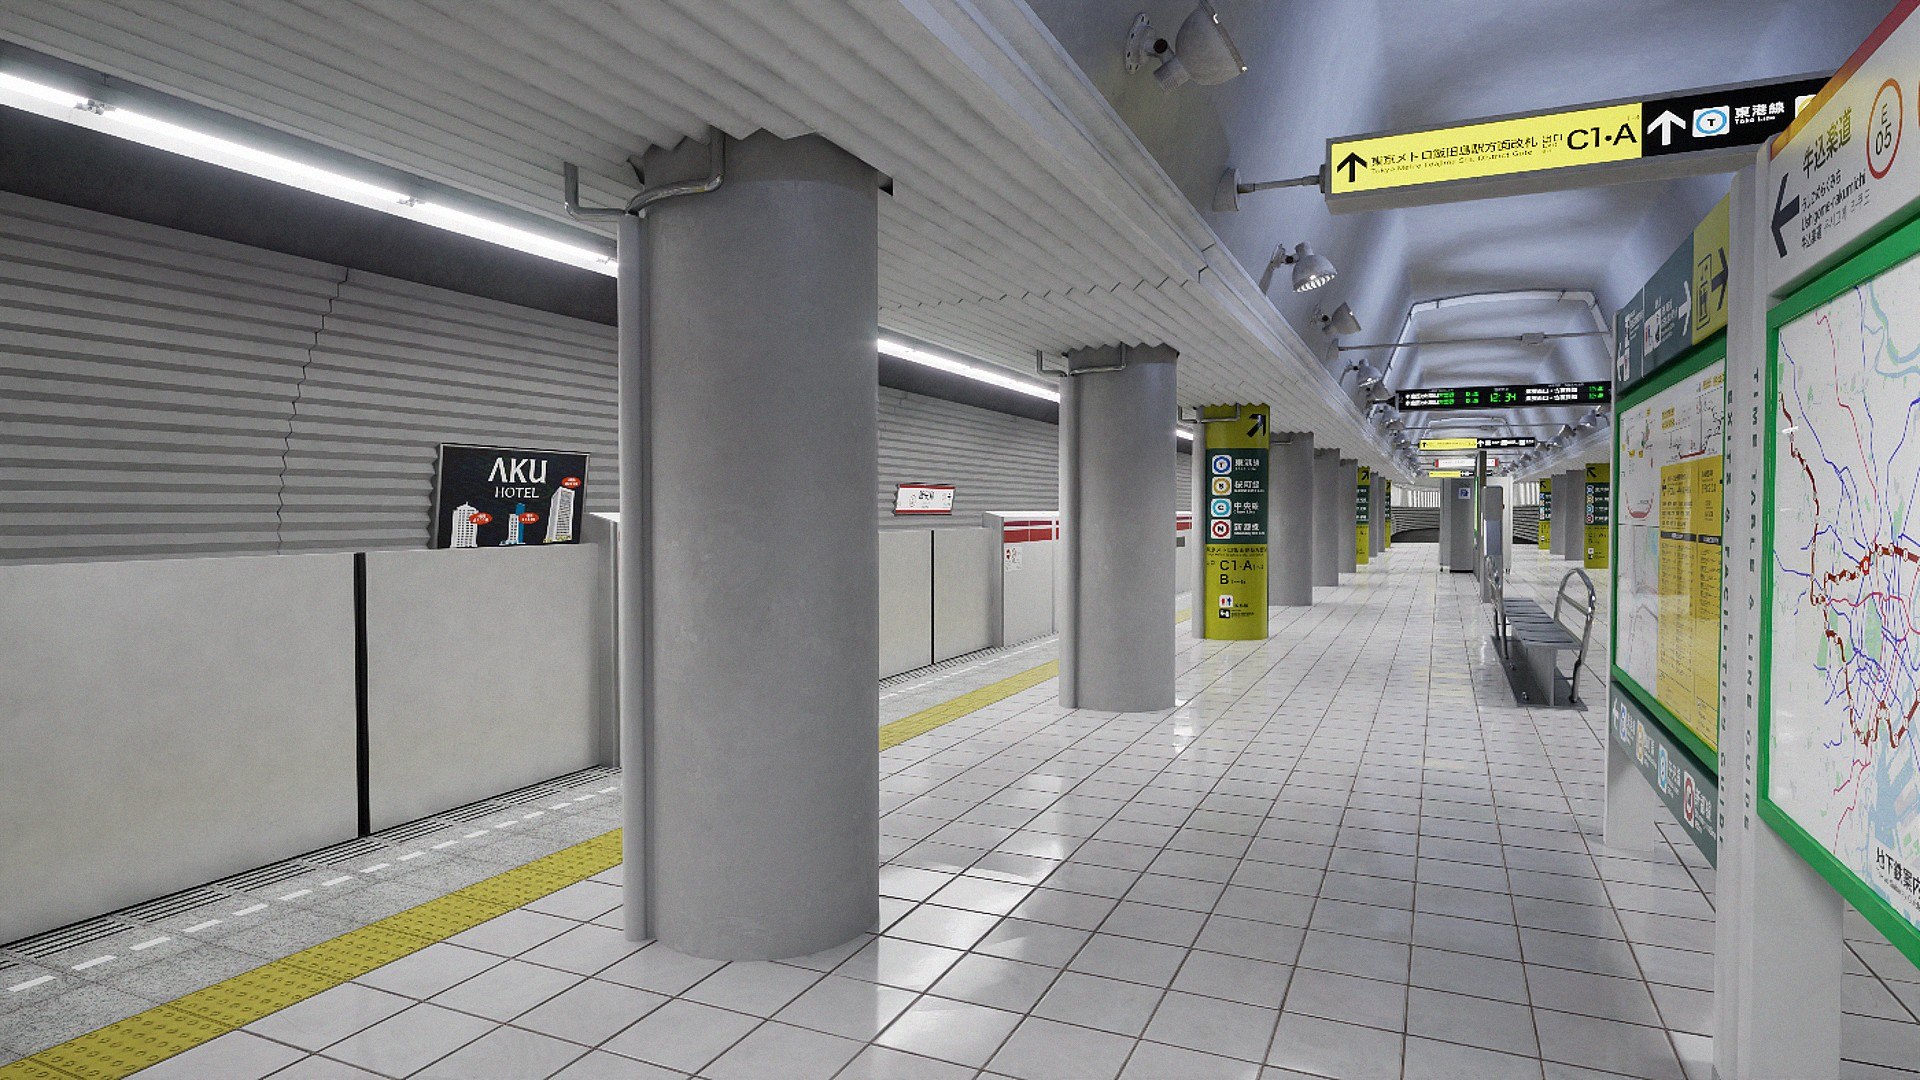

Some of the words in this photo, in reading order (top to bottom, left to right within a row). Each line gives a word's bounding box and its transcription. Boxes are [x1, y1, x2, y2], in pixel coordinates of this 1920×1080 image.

[1881, 103, 1889, 125] E
[1875, 122, 1892, 156] 05
[1490, 392, 1517, 403] 12:34
[1752, 366, 1760, 448] TIME
[494, 486, 540, 499] HOTEL
[1220, 573, 1230, 585] B
[1746, 632, 1755, 709] LINE
[1743, 729, 1752, 831] GUIDE
